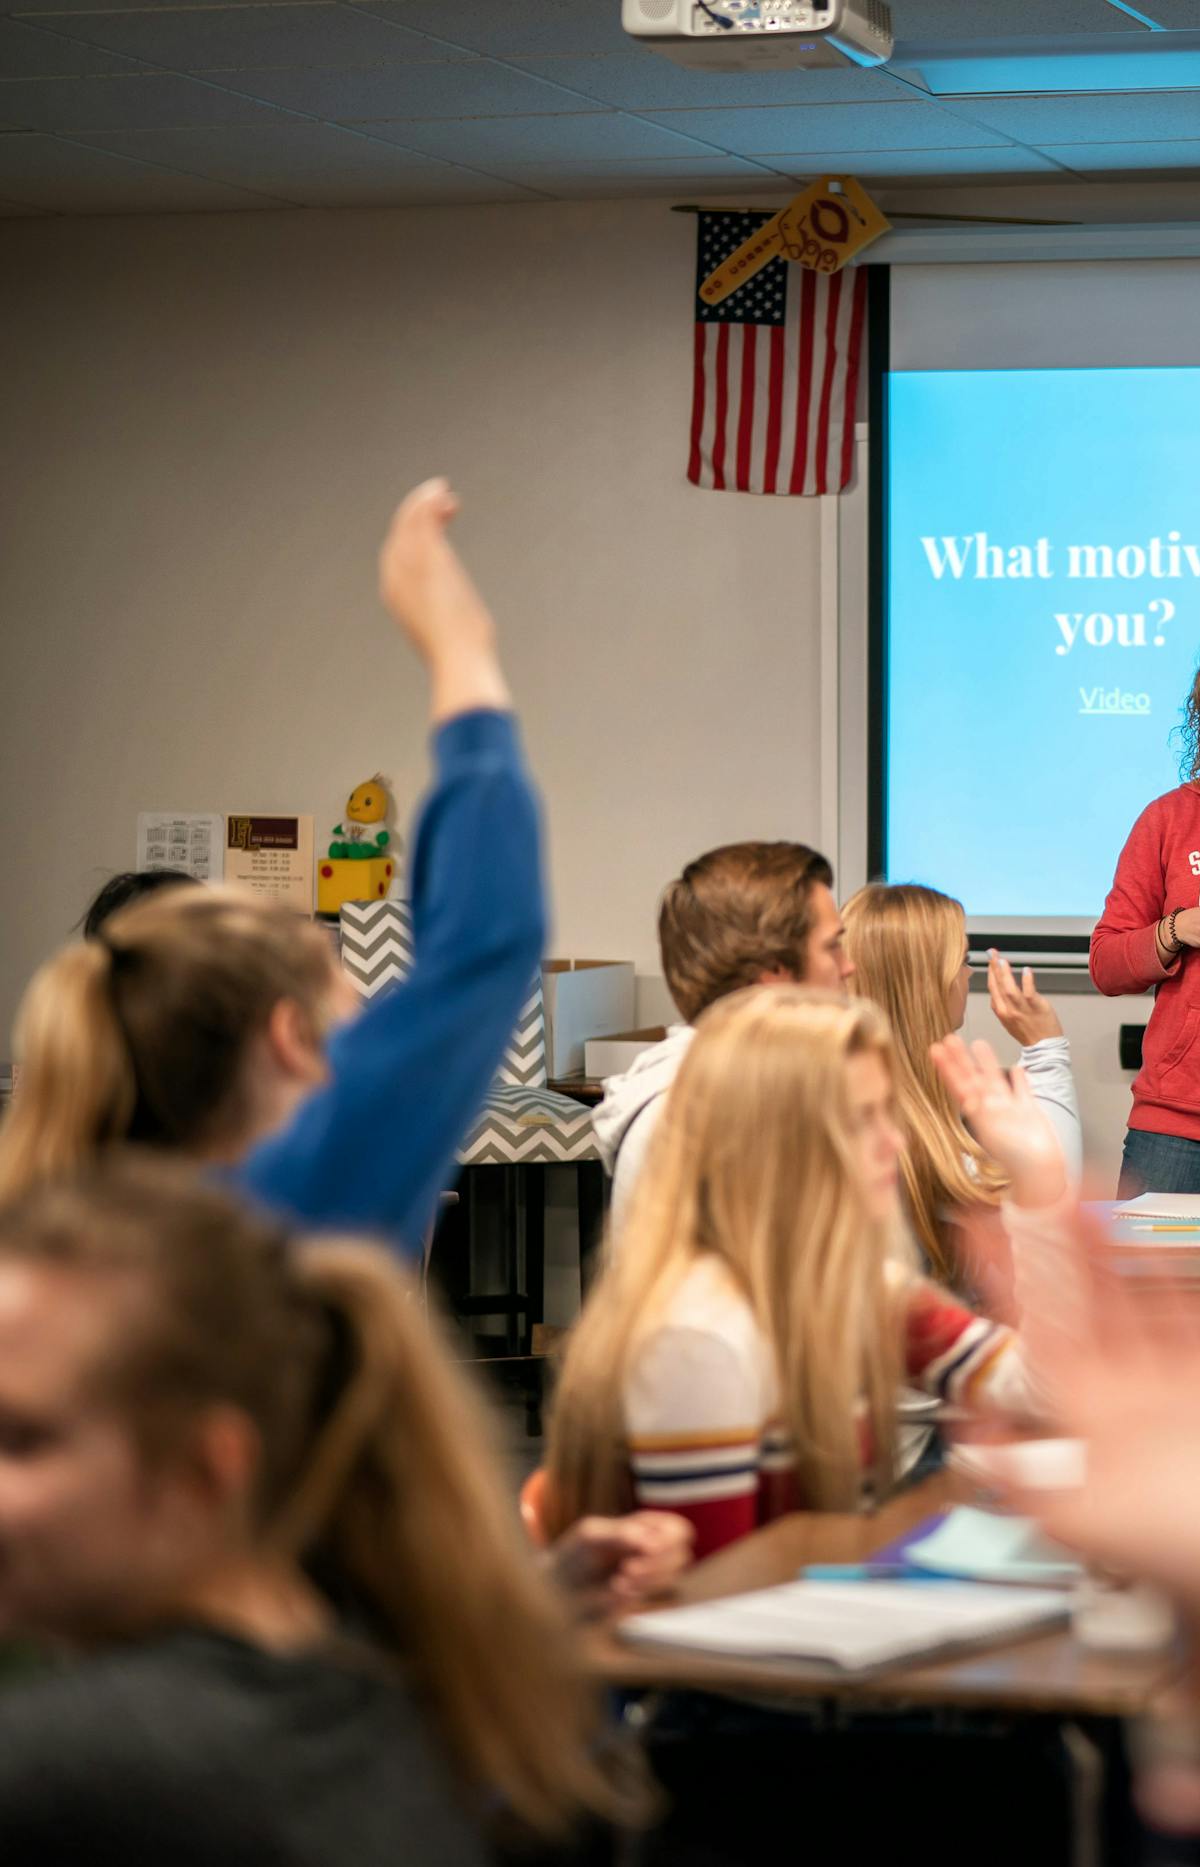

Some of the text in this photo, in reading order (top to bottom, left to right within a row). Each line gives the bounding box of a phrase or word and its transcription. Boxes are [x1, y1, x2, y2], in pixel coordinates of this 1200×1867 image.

[921, 532, 1054, 579] What
[1054, 599, 1175, 656] you?
[1079, 687, 1151, 712] Video
